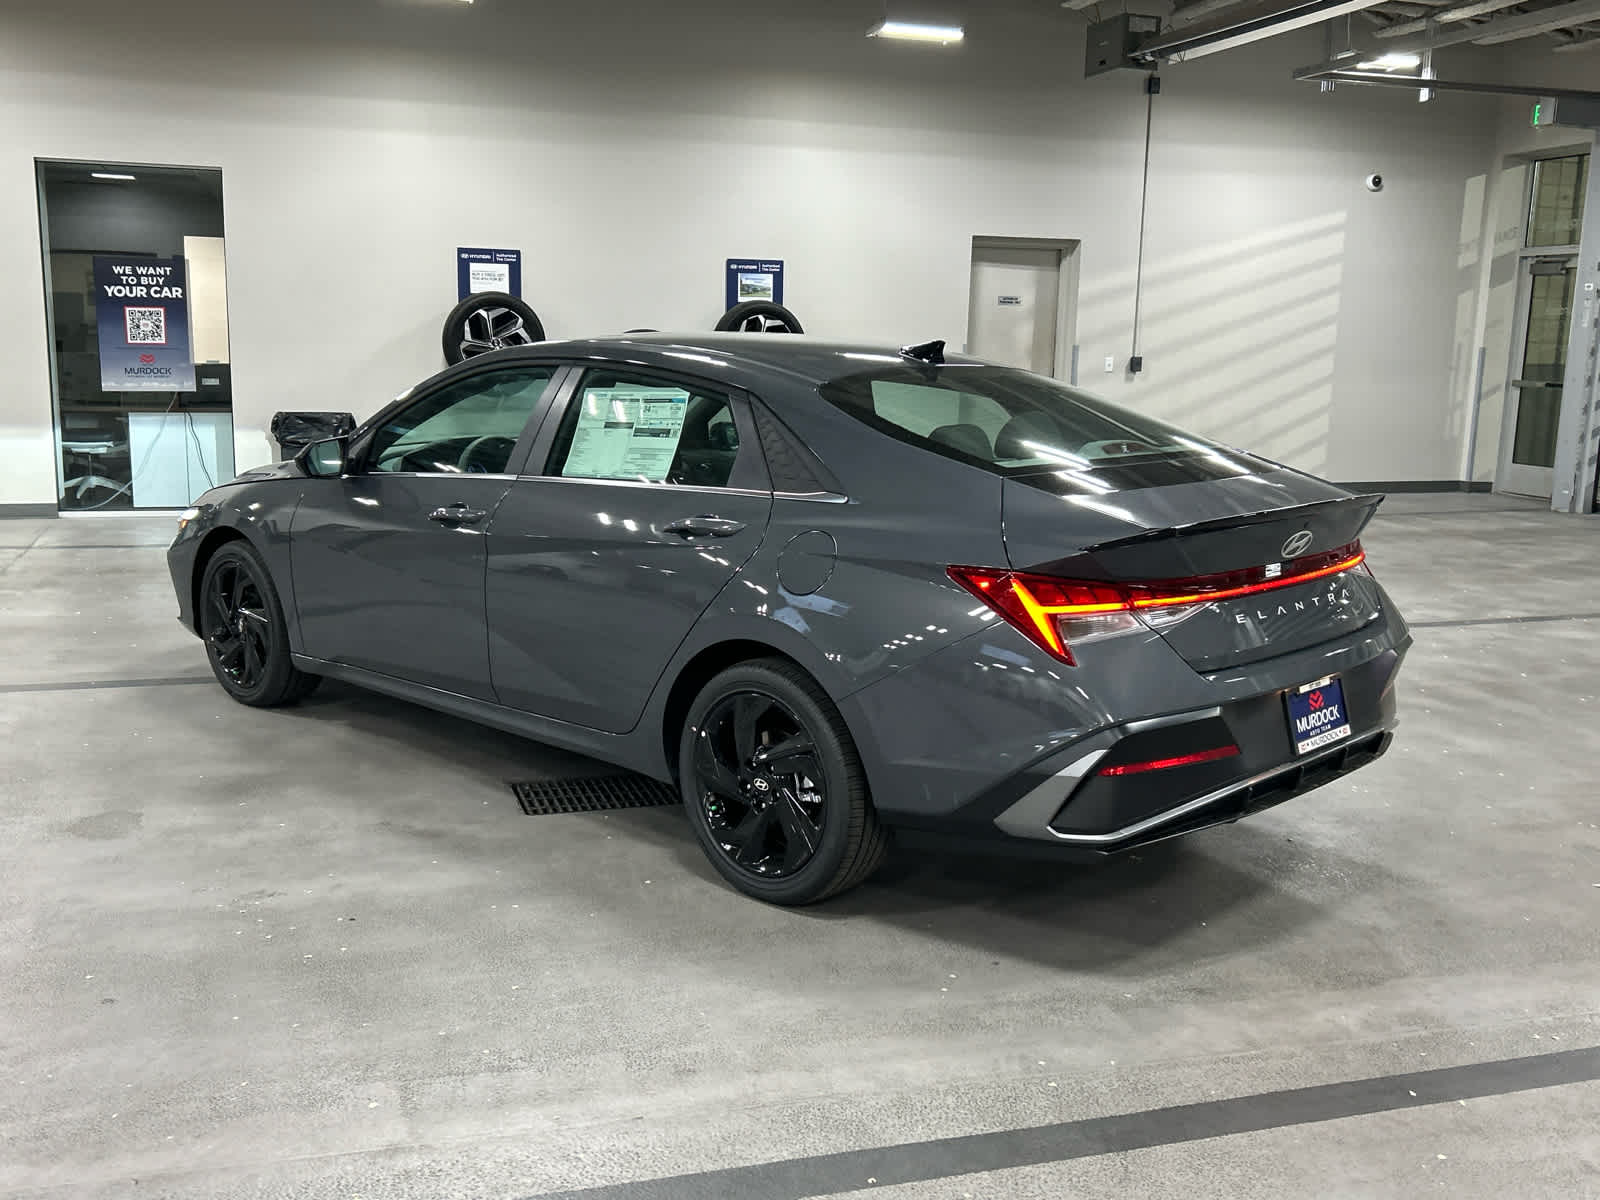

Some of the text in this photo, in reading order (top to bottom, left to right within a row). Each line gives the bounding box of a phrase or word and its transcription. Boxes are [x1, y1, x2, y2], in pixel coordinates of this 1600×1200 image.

[112, 265, 172, 276] WE WANT
[121, 276, 164, 286] TO BUY
[104, 285, 183, 298] YOUR CAR
[124, 367, 172, 376] MURDOCK
[1235, 588, 1350, 624] ELANTRA
[1296, 704, 1340, 733] MURDOCK
[1310, 730, 1339, 747] MURDOCK
